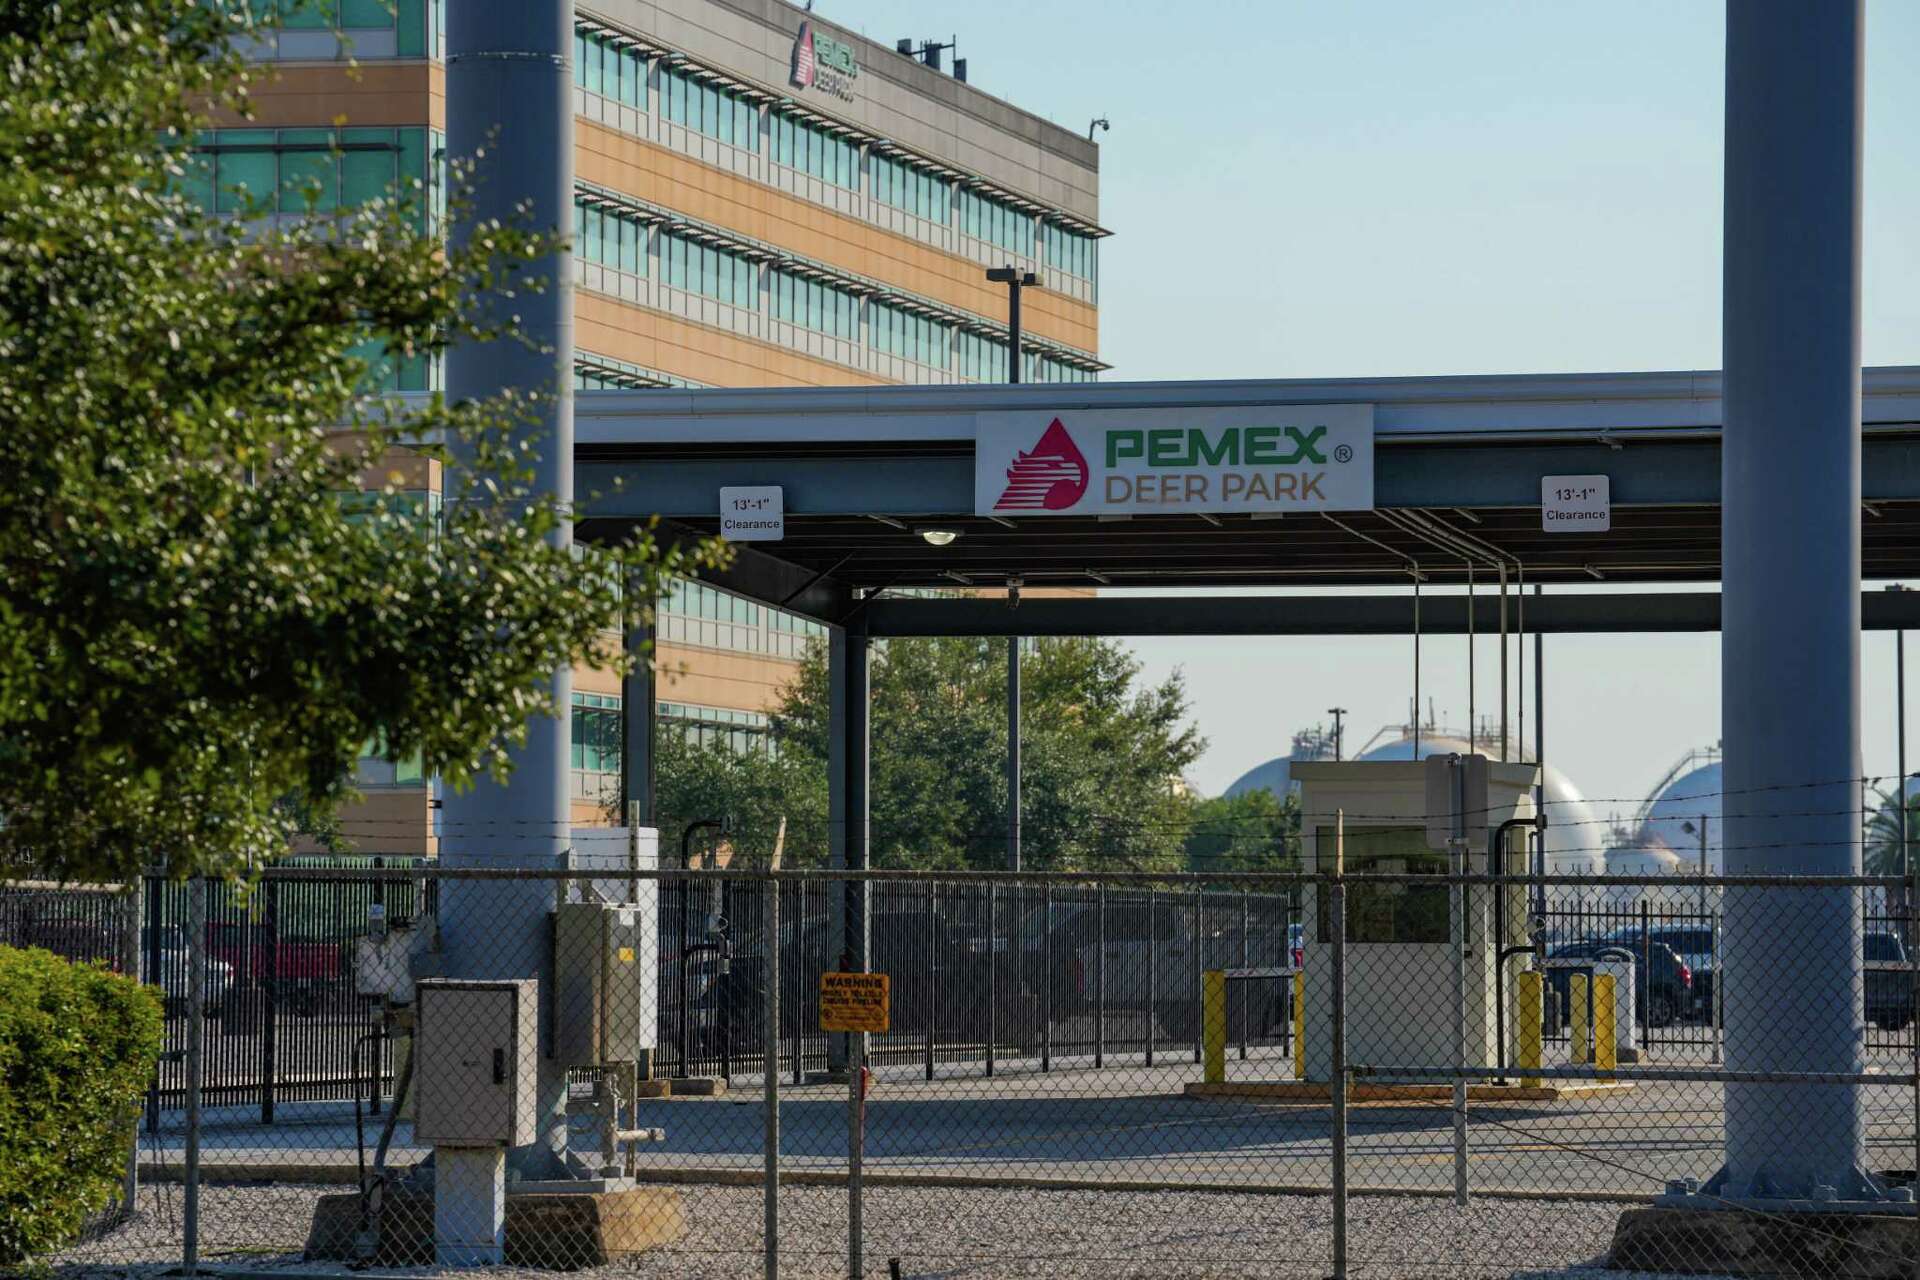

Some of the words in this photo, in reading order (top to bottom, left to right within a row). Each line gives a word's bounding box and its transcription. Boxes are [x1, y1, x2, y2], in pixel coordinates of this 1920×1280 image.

[1105, 426, 1327, 467] PEMEX
[1105, 475, 1208, 504] DEER
[1222, 471, 1327, 501] PARK
[1555, 488, 1595, 500] 13'-1"
[732, 498, 769, 510] 13'-1"
[1546, 511, 1606, 520] Clearance
[724, 520, 780, 529] Clearance
[826, 977, 883, 988] WARNING
